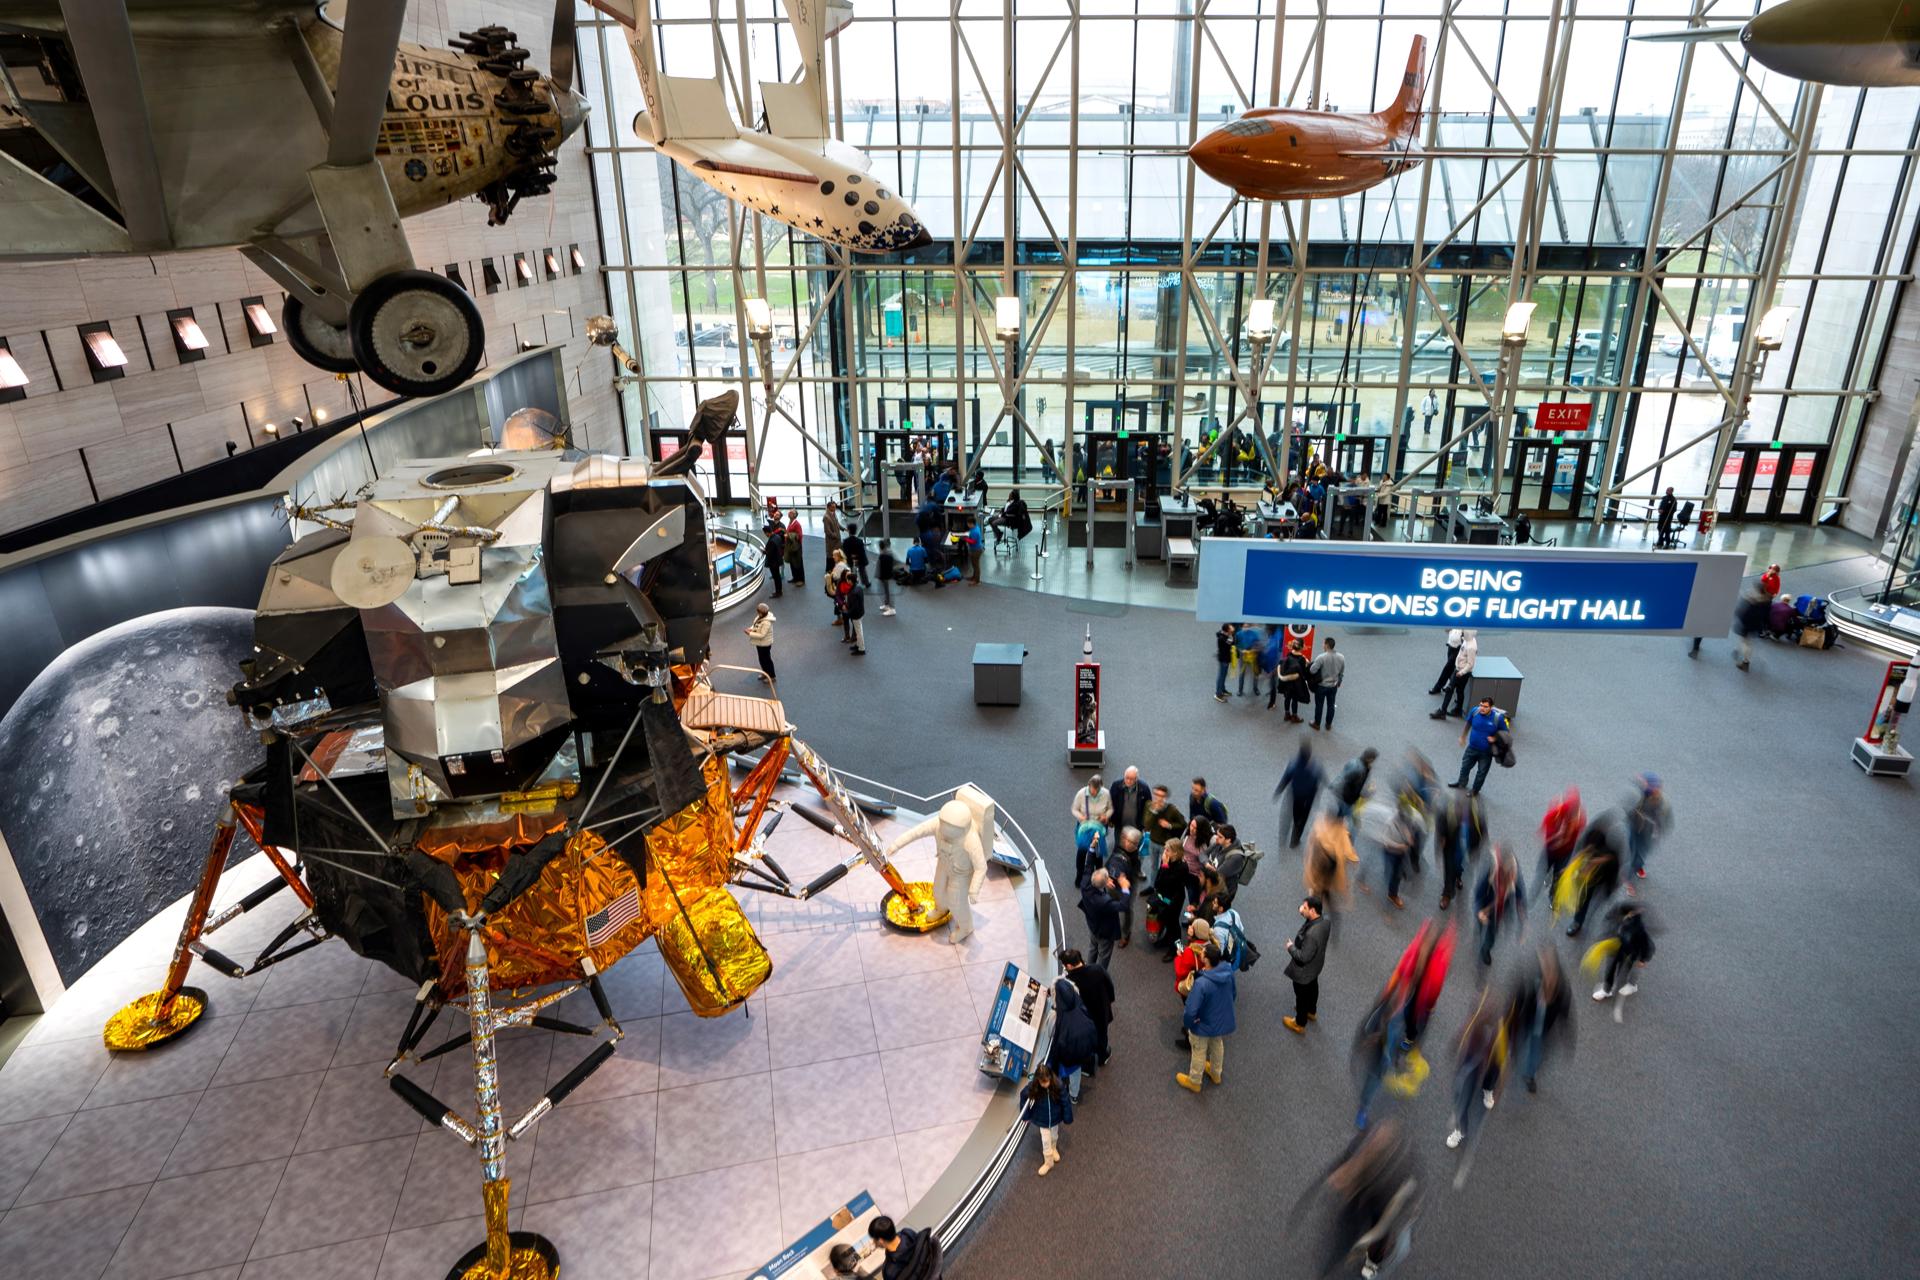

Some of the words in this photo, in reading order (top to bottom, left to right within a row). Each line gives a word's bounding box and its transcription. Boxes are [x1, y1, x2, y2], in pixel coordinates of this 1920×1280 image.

[397, 78, 427, 92] of
[385, 87, 485, 112] Louis
[1549, 409, 1581, 419] EXIT
[1420, 567, 1523, 592] BOEING
[1286, 588, 1439, 617] MILESTONES
[1444, 596, 1480, 618] OF
[1485, 597, 1578, 620] FLIGHT
[1580, 599, 1645, 620] HALL
